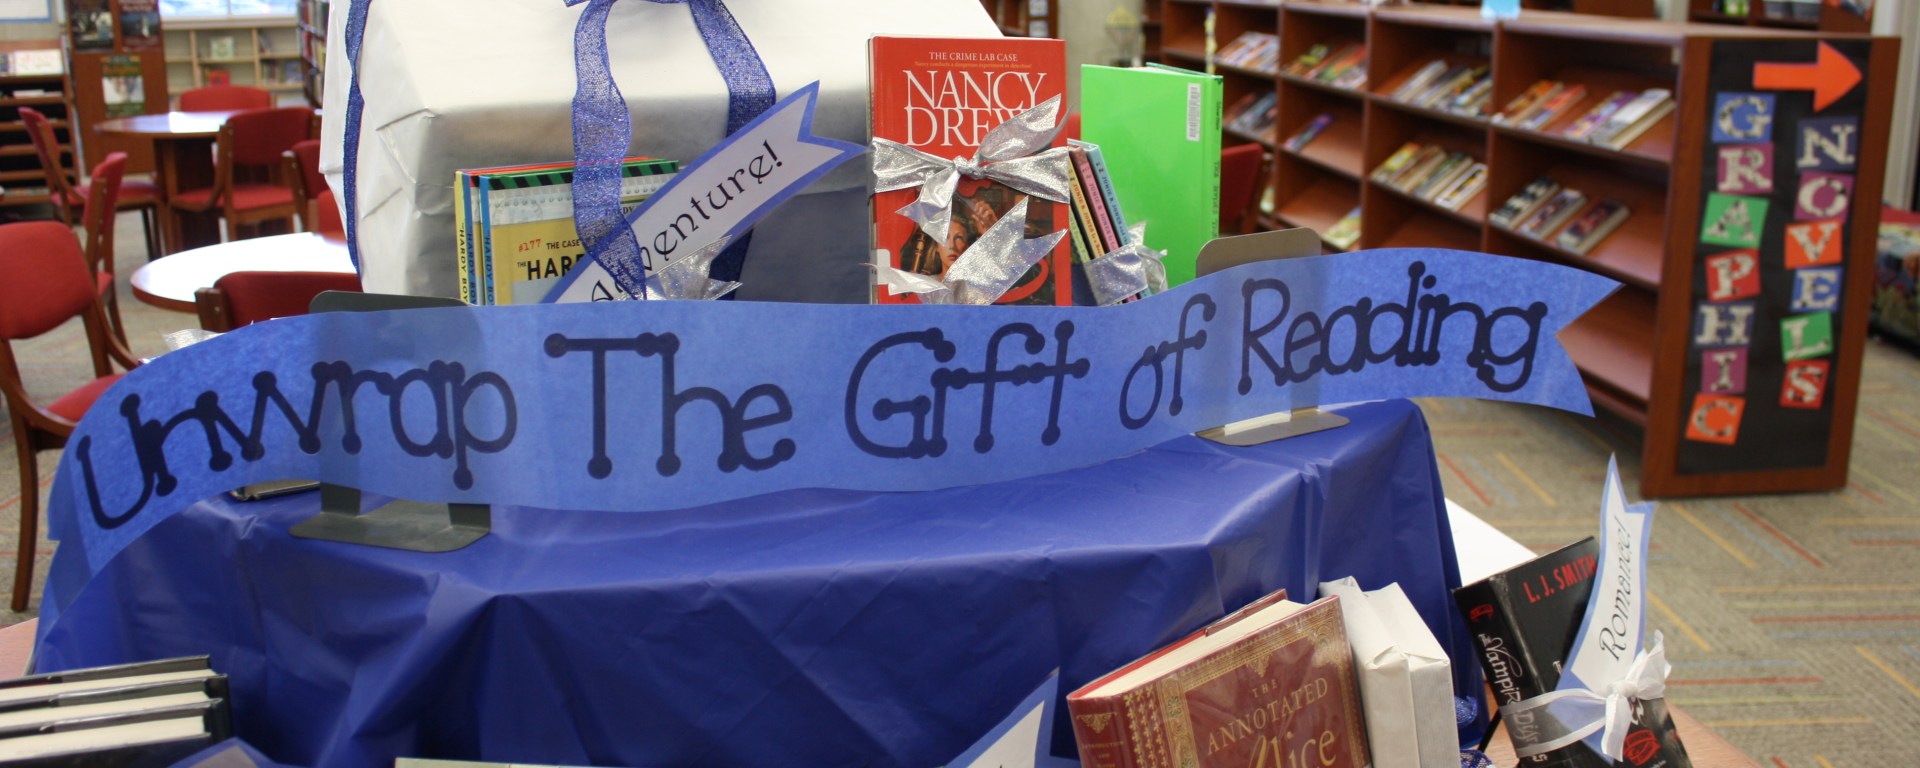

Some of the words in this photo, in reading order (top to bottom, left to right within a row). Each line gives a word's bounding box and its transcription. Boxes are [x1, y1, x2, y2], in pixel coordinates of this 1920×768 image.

[928, 51, 947, 60] THE
[949, 52, 977, 60] CRIME
[979, 53, 995, 61] LAB
[996, 53, 1018, 62] CASE
[902, 70, 1047, 116] NANCY
[459, 229, 467, 273] HARDY
[467, 233, 475, 274] HARDY
[484, 237, 493, 280] HARDY
[517, 238, 542, 252] #177
[546, 242, 560, 250] THE
[562, 239, 581, 248] CASE
[527, 254, 586, 281] HAR
[487, 286, 495, 305] BO
[76, 360, 518, 530] Unwrap
[543, 331, 797, 480] The
[844, 319, 1091, 460] Gift
[1118, 292, 1216, 430] of
[1237, 260, 1549, 396] Reading
[1522, 581, 1541, 604] L.
[1540, 574, 1556, 597] J.
[1552, 553, 1598, 591] SMITH
[1599, 514, 1633, 662] Romance!
[1251, 678, 1279, 699] THE
[1207, 677, 1329, 757] ANNOTATED
